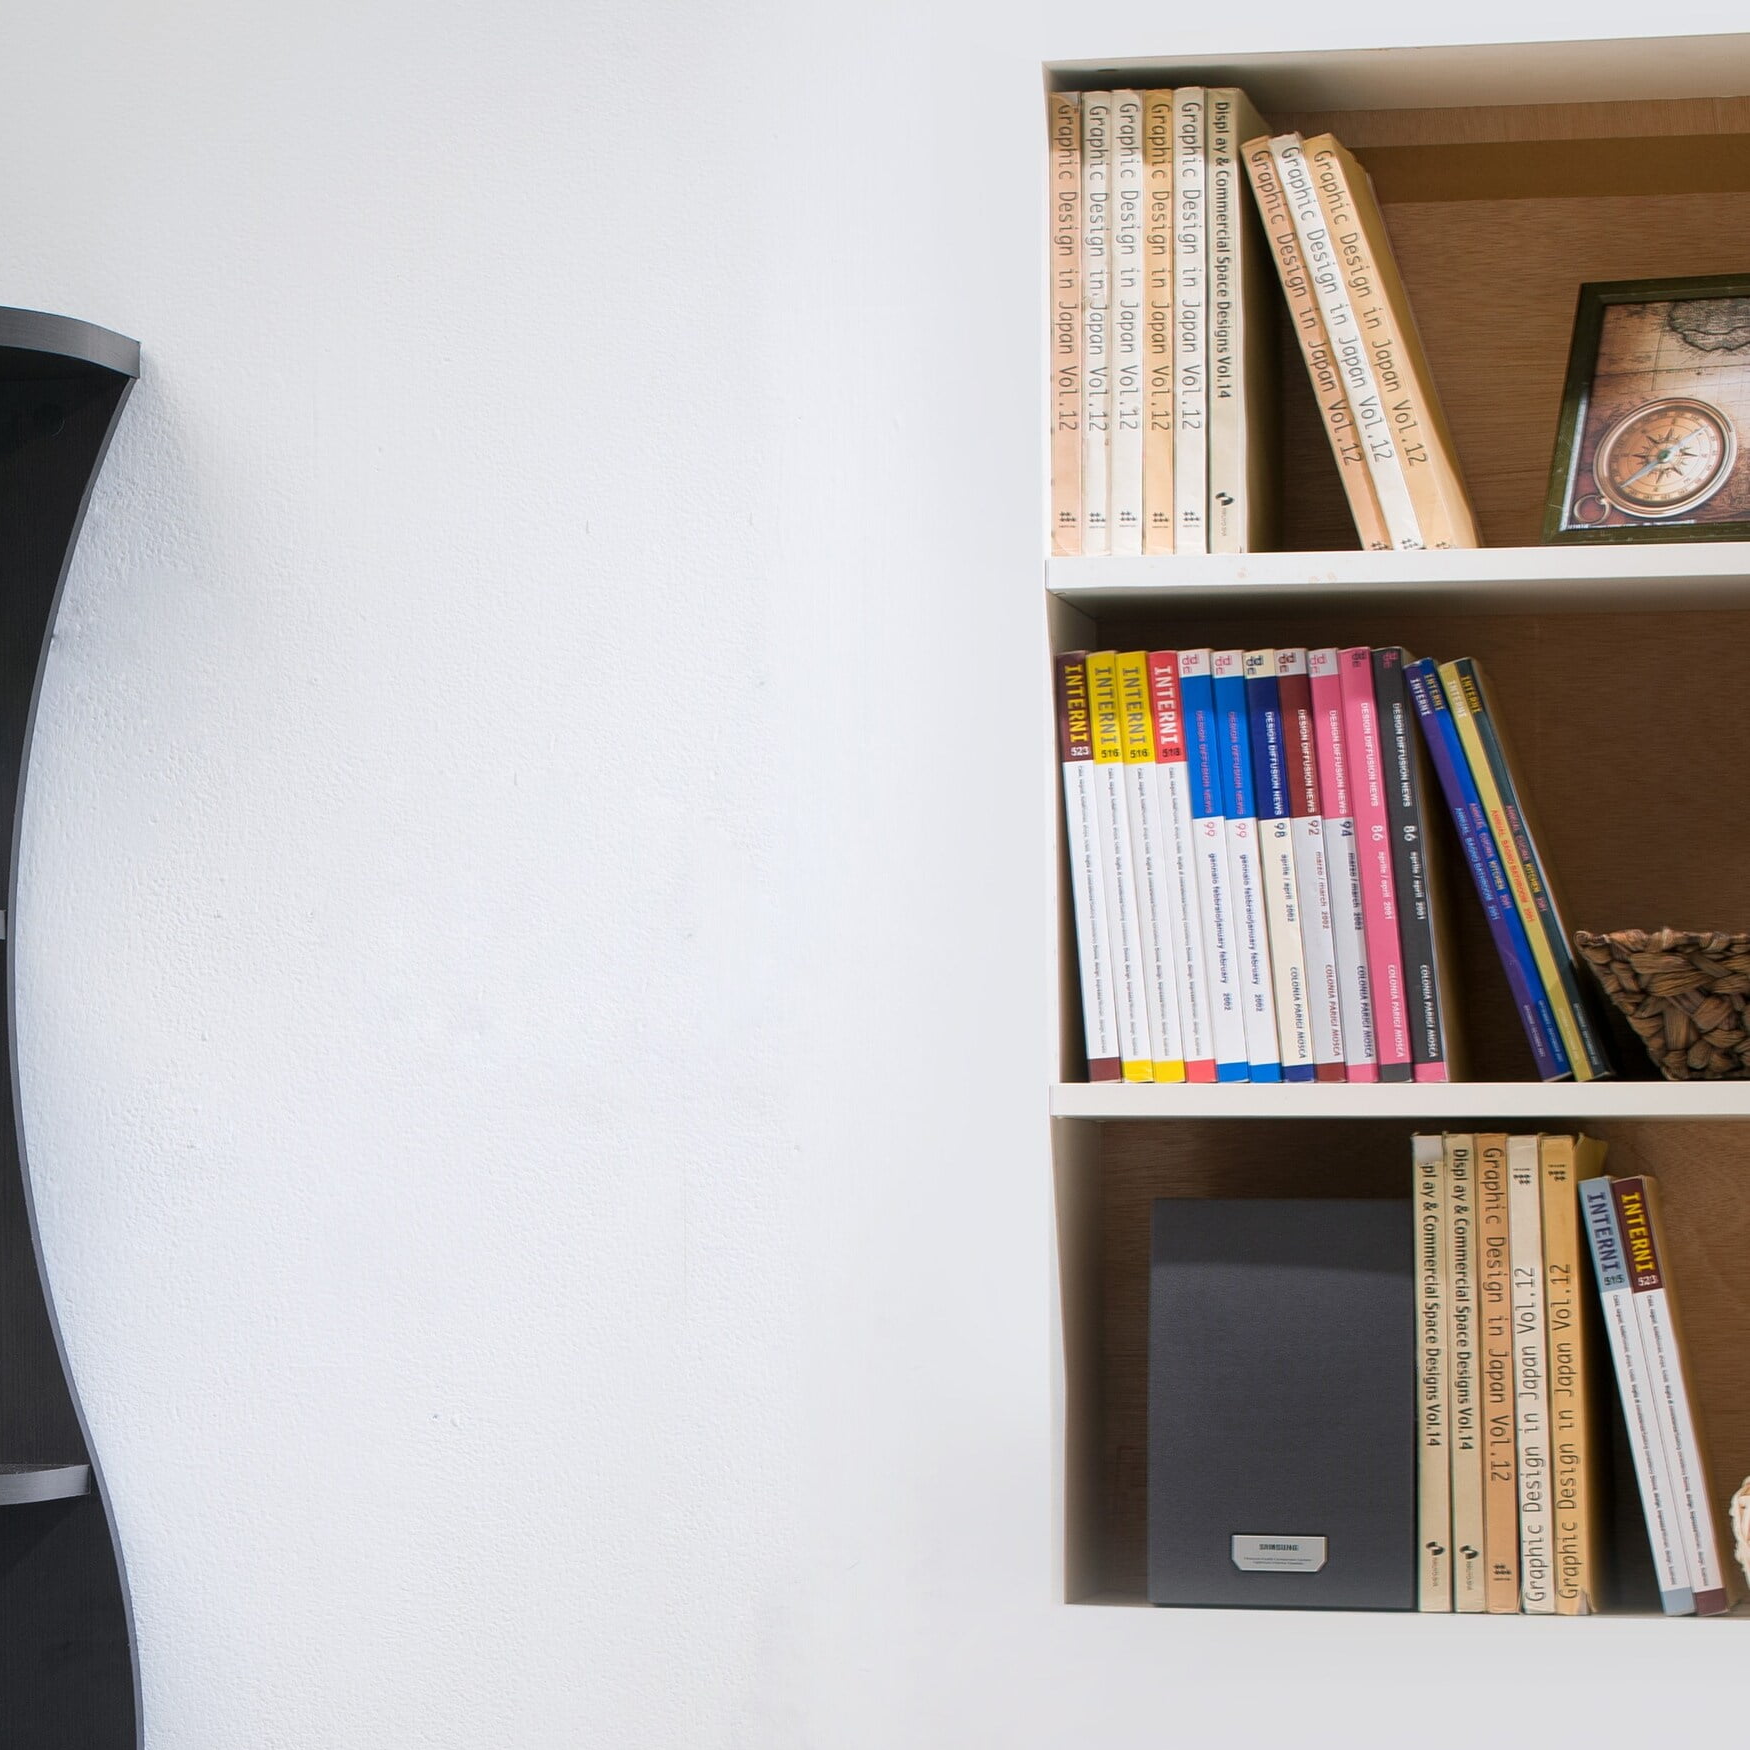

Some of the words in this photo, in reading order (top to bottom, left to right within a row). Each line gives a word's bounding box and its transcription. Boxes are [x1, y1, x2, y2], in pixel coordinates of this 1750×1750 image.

[1086, 105, 1109, 180] Graphic
[1116, 103, 1142, 177] Graphic
[1147, 103, 1171, 178] Graphic
[1178, 102, 1204, 177] Graphic
[1216, 157, 1232, 166] &
[1216, 170, 1231, 252] Commercial
[1280, 147, 1318, 220] Graphic
[1314, 145, 1349, 224] Graphic
[1086, 192, 1109, 256] Design
[1116, 190, 1141, 254] Design
[1147, 190, 1171, 254] Design
[1178, 189, 1202, 253] Design
[1089, 270, 1109, 289] in
[1121, 267, 1140, 287] in
[1152, 268, 1171, 287] in
[1183, 266, 1202, 286] in
[1215, 256, 1231, 296] Space
[1307, 227, 1338, 294] Design
[1338, 232, 1372, 297] Design
[1086, 302, 1109, 354] Japan
[1116, 300, 1139, 352] Japan
[1148, 300, 1171, 353] Japan
[1178, 299, 1201, 352] Japan
[1215, 301, 1231, 353] Designs
[1332, 303, 1349, 325] in
[1363, 306, 1382, 329] in
[1217, 356, 1232, 397] Vol.14
[1337, 337, 1368, 391] Japan
[1372, 339, 1402, 392] Japan
[1089, 366, 1109, 431] Vol.12
[1120, 364, 1139, 429] Vol.12
[1152, 365, 1171, 430] Vol.12
[1182, 364, 1202, 429] Vol.12
[1357, 396, 1393, 464] Vol.12
[1392, 399, 1428, 466] Vol.12
[1065, 665, 1088, 742] INTERNI
[1095, 666, 1117, 744] INTERNI
[1123, 666, 1146, 744] INTERNI
[1155, 665, 1178, 744] INTERNI
[1393, 702, 1404, 734] DESIGN
[1411, 678, 1431, 715] INTERNI
[1426, 674, 1443, 711] INTERNI
[1462, 675, 1481, 714] INTERNI
[1397, 735, 1409, 780] DIFFUSION
[1402, 781, 1412, 806] NEWS
[1403, 825, 1417, 842] 86
[1421, 964, 1432, 999] COLONIA
[1425, 1001, 1435, 1027] PARIGI
[1428, 1029, 1438, 1056] MOSCA
[1454, 1205, 1469, 1214] &
[1481, 1147, 1507, 1223] Graphic
[1588, 1192, 1621, 1271] INTERNI
[1622, 1192, 1654, 1272] INTERNI
[1455, 1218, 1471, 1301] Commercial
[1483, 1236, 1508, 1302] Design
[1511, 1267, 1536, 1334] Vol.12
[1547, 1264, 1572, 1330] Vol.12
[1454, 1305, 1471, 1346] Space
[1489, 1315, 1509, 1335] in
[1455, 1351, 1472, 1403] Designs
[1485, 1348, 1510, 1402] Japan
[1515, 1346, 1542, 1401] Japan
[1549, 1342, 1576, 1397] Japan
[1458, 1407, 1474, 1449] Vol.14
[1490, 1415, 1512, 1480] Vol.12
[1519, 1413, 1539, 1433] in
[1551, 1410, 1574, 1430] in
[1521, 1446, 1545, 1512] Design
[1552, 1443, 1579, 1509] Design
[1524, 1524, 1550, 1601] Graphic
[1555, 1522, 1583, 1598] Graphic
